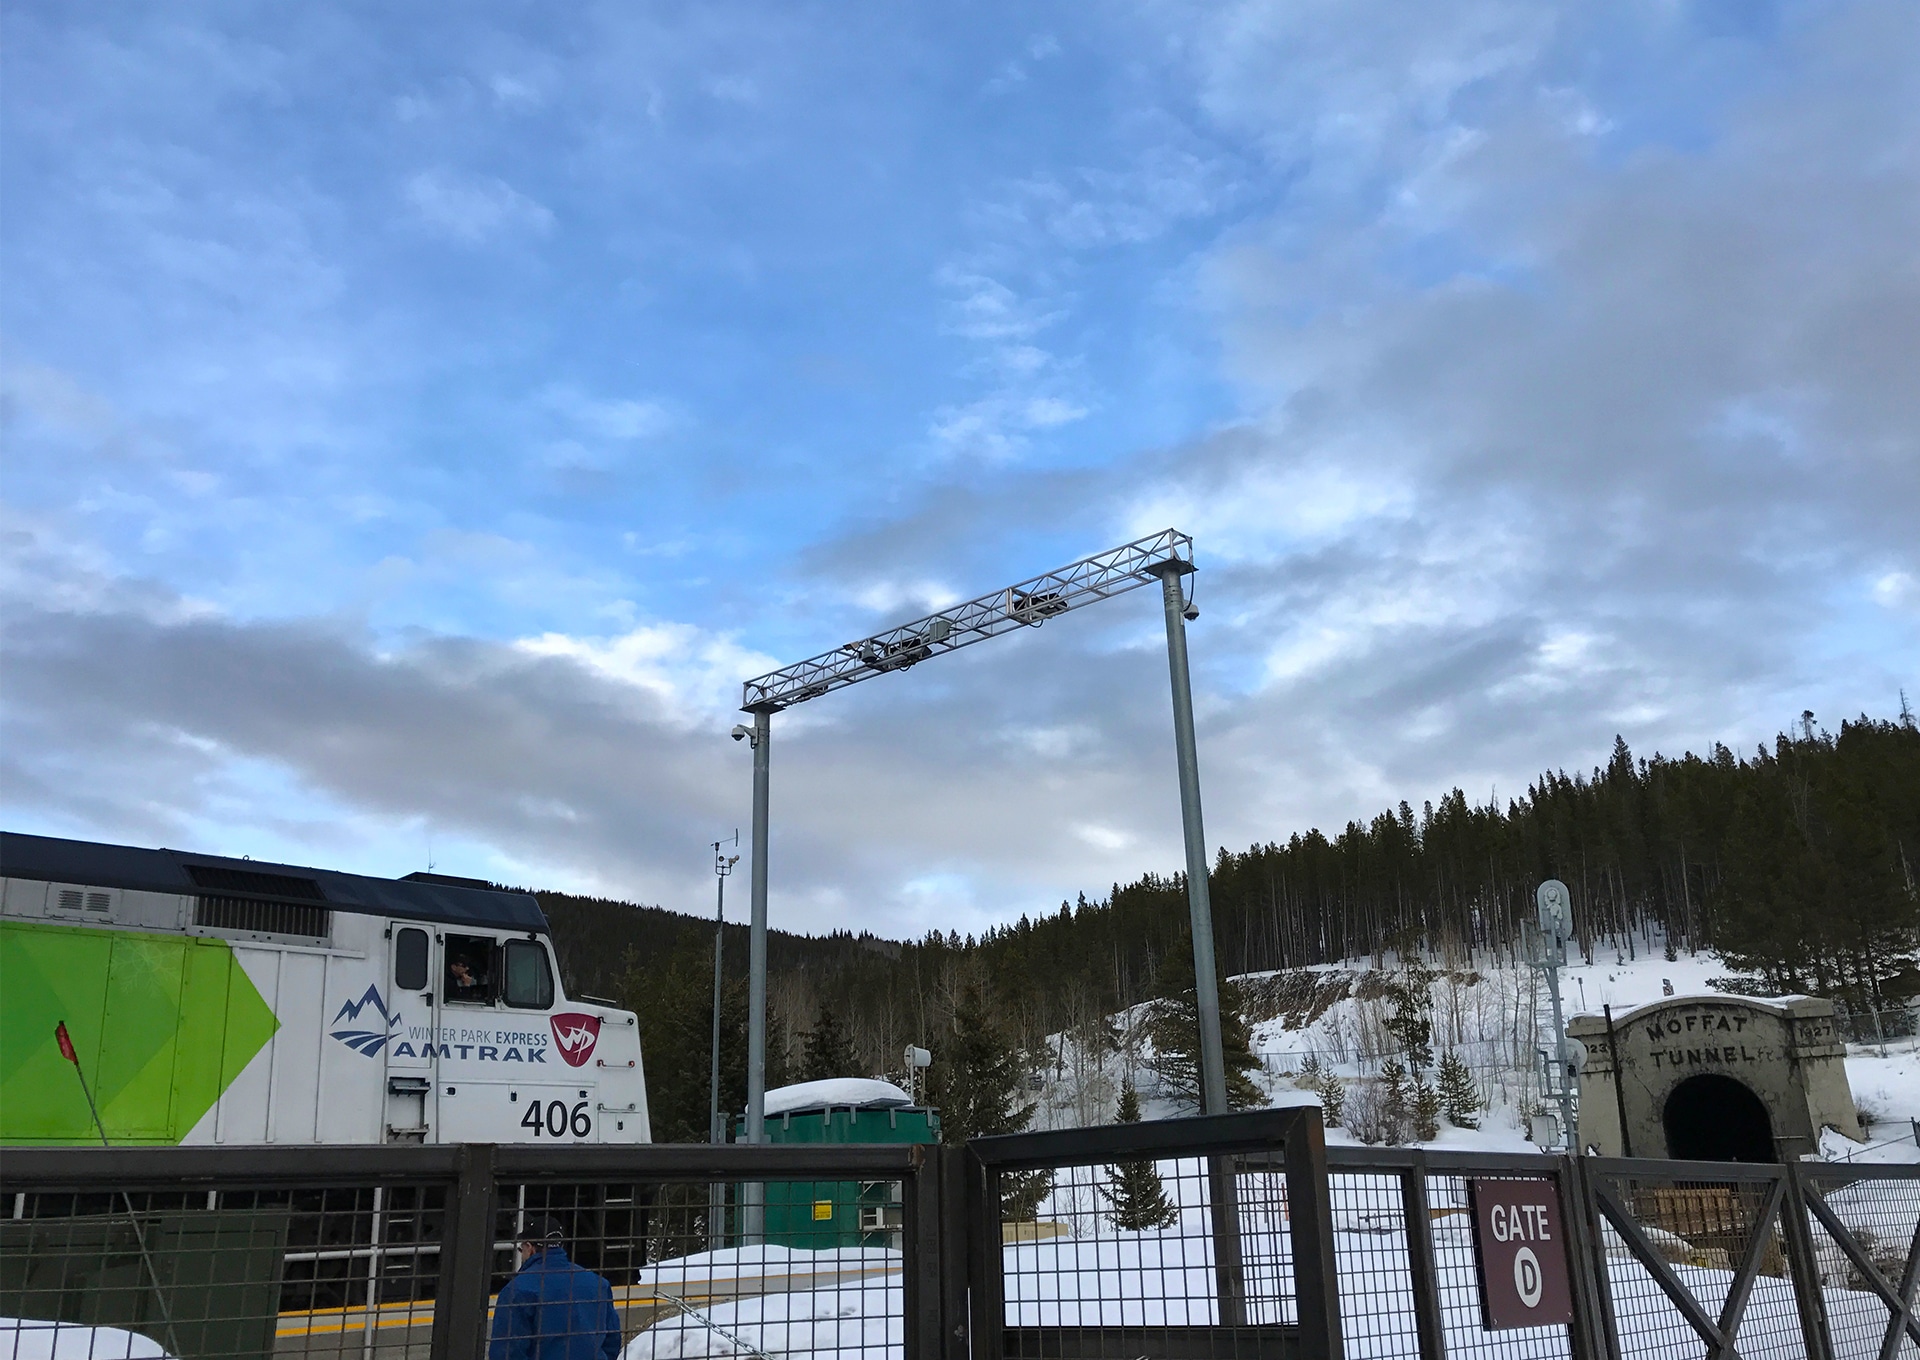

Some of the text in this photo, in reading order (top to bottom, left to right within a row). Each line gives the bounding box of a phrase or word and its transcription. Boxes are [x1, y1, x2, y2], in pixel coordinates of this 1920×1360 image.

[408, 1026, 548, 1046] WINTER PARK EXPRESS
[1646, 1014, 1748, 1042] MOFFAT
[1799, 1025, 1831, 1038] 1927
[393, 1041, 547, 1064] AMTRAK
[1650, 1043, 1756, 1068] TUNNEL
[520, 1100, 592, 1138] 406
[1491, 1204, 1551, 1242] GATE
[1520, 1259, 1537, 1296] D
